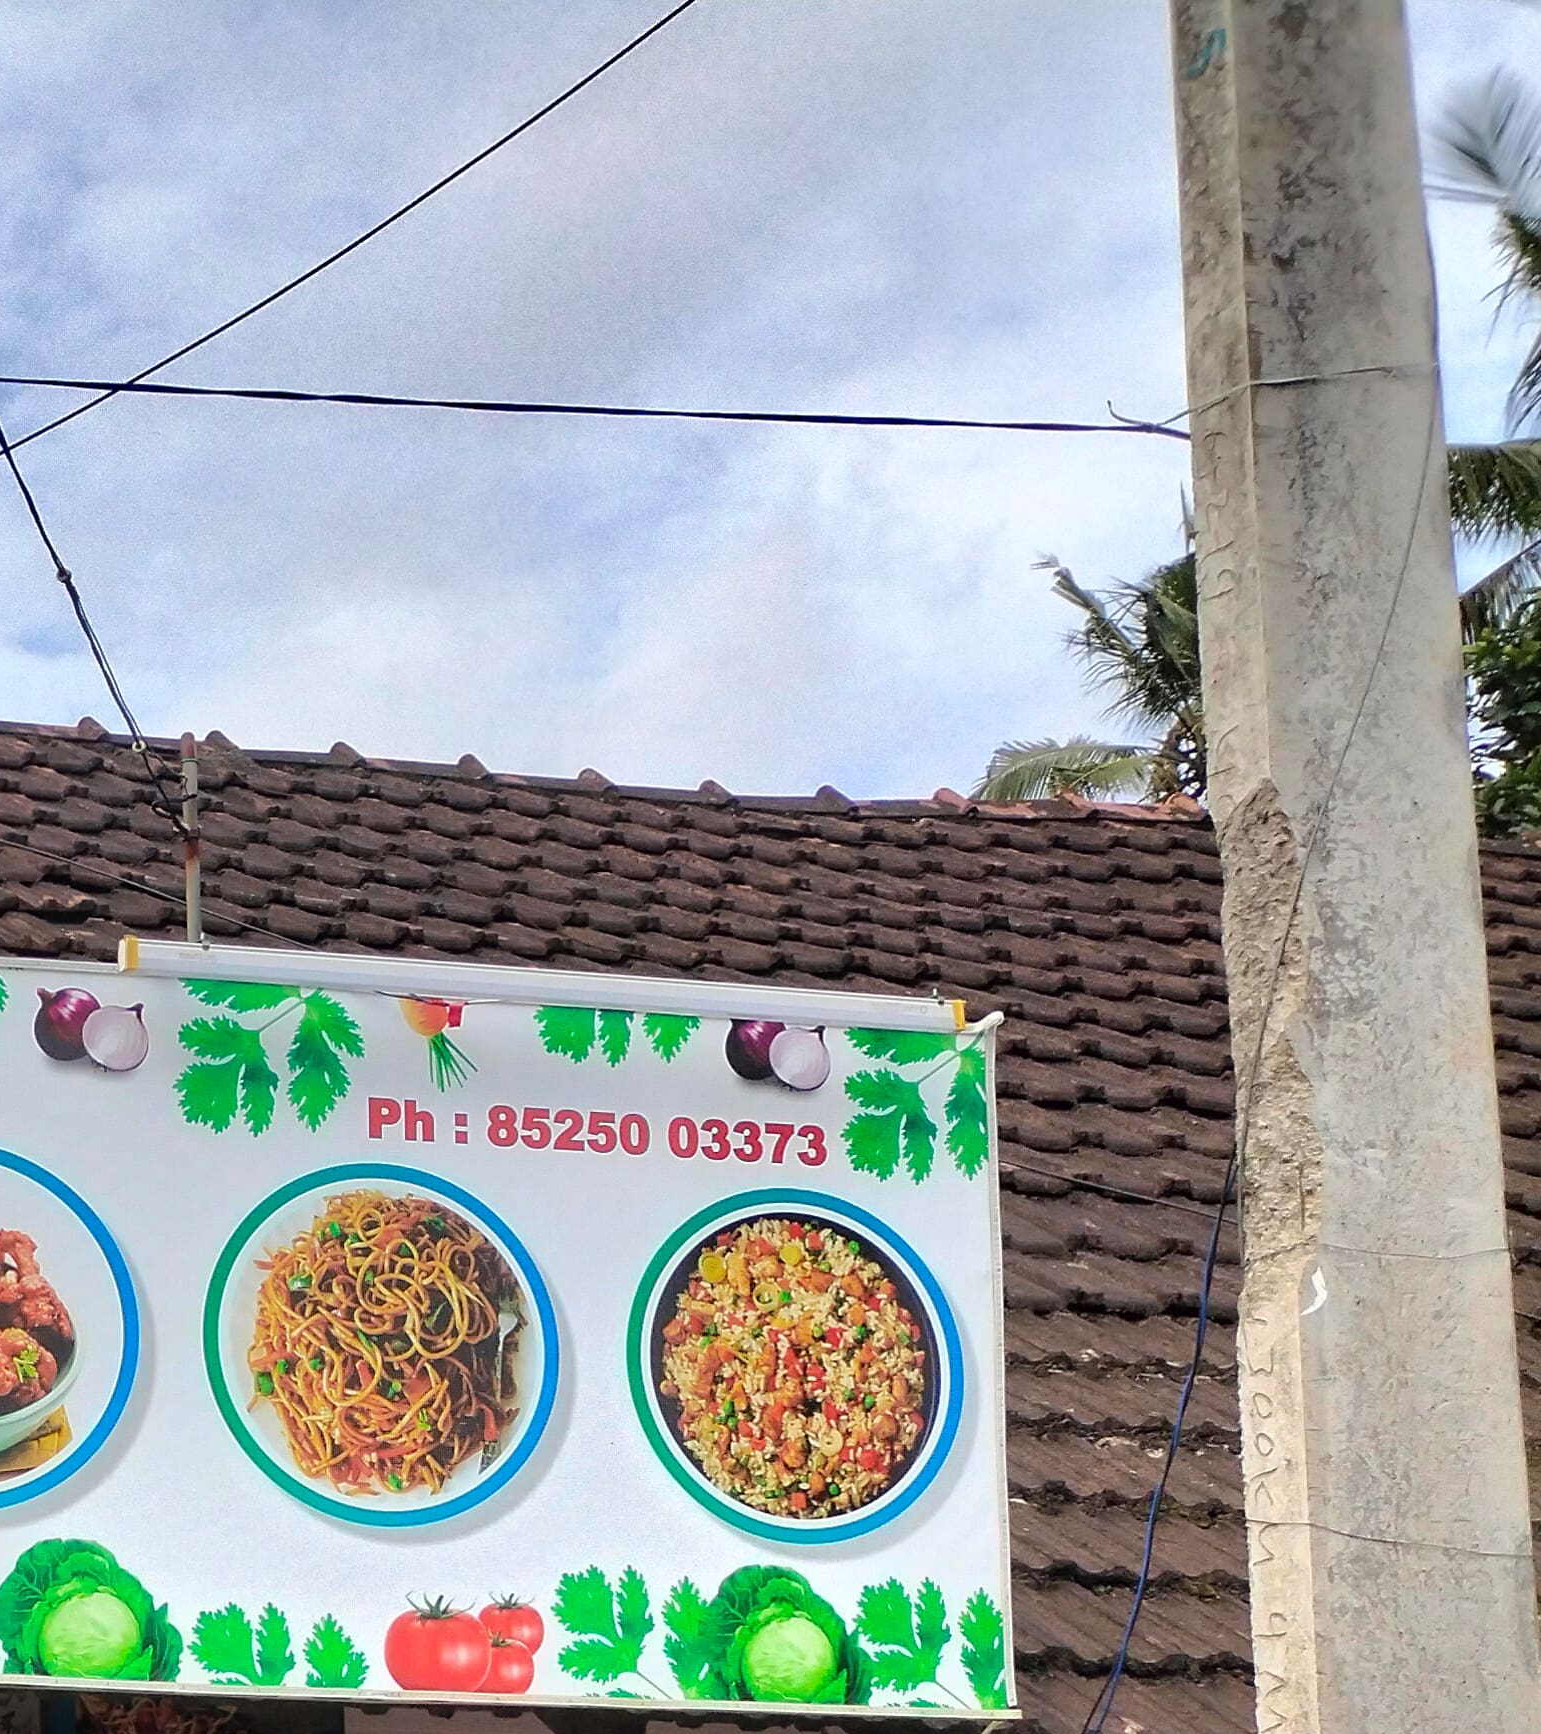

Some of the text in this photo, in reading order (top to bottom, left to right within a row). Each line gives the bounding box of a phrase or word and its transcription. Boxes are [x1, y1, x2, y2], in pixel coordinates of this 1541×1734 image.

[368, 1097, 435, 1142] Ph
[487, 1104, 650, 1156] 85250
[667, 1117, 829, 1167] 03373
